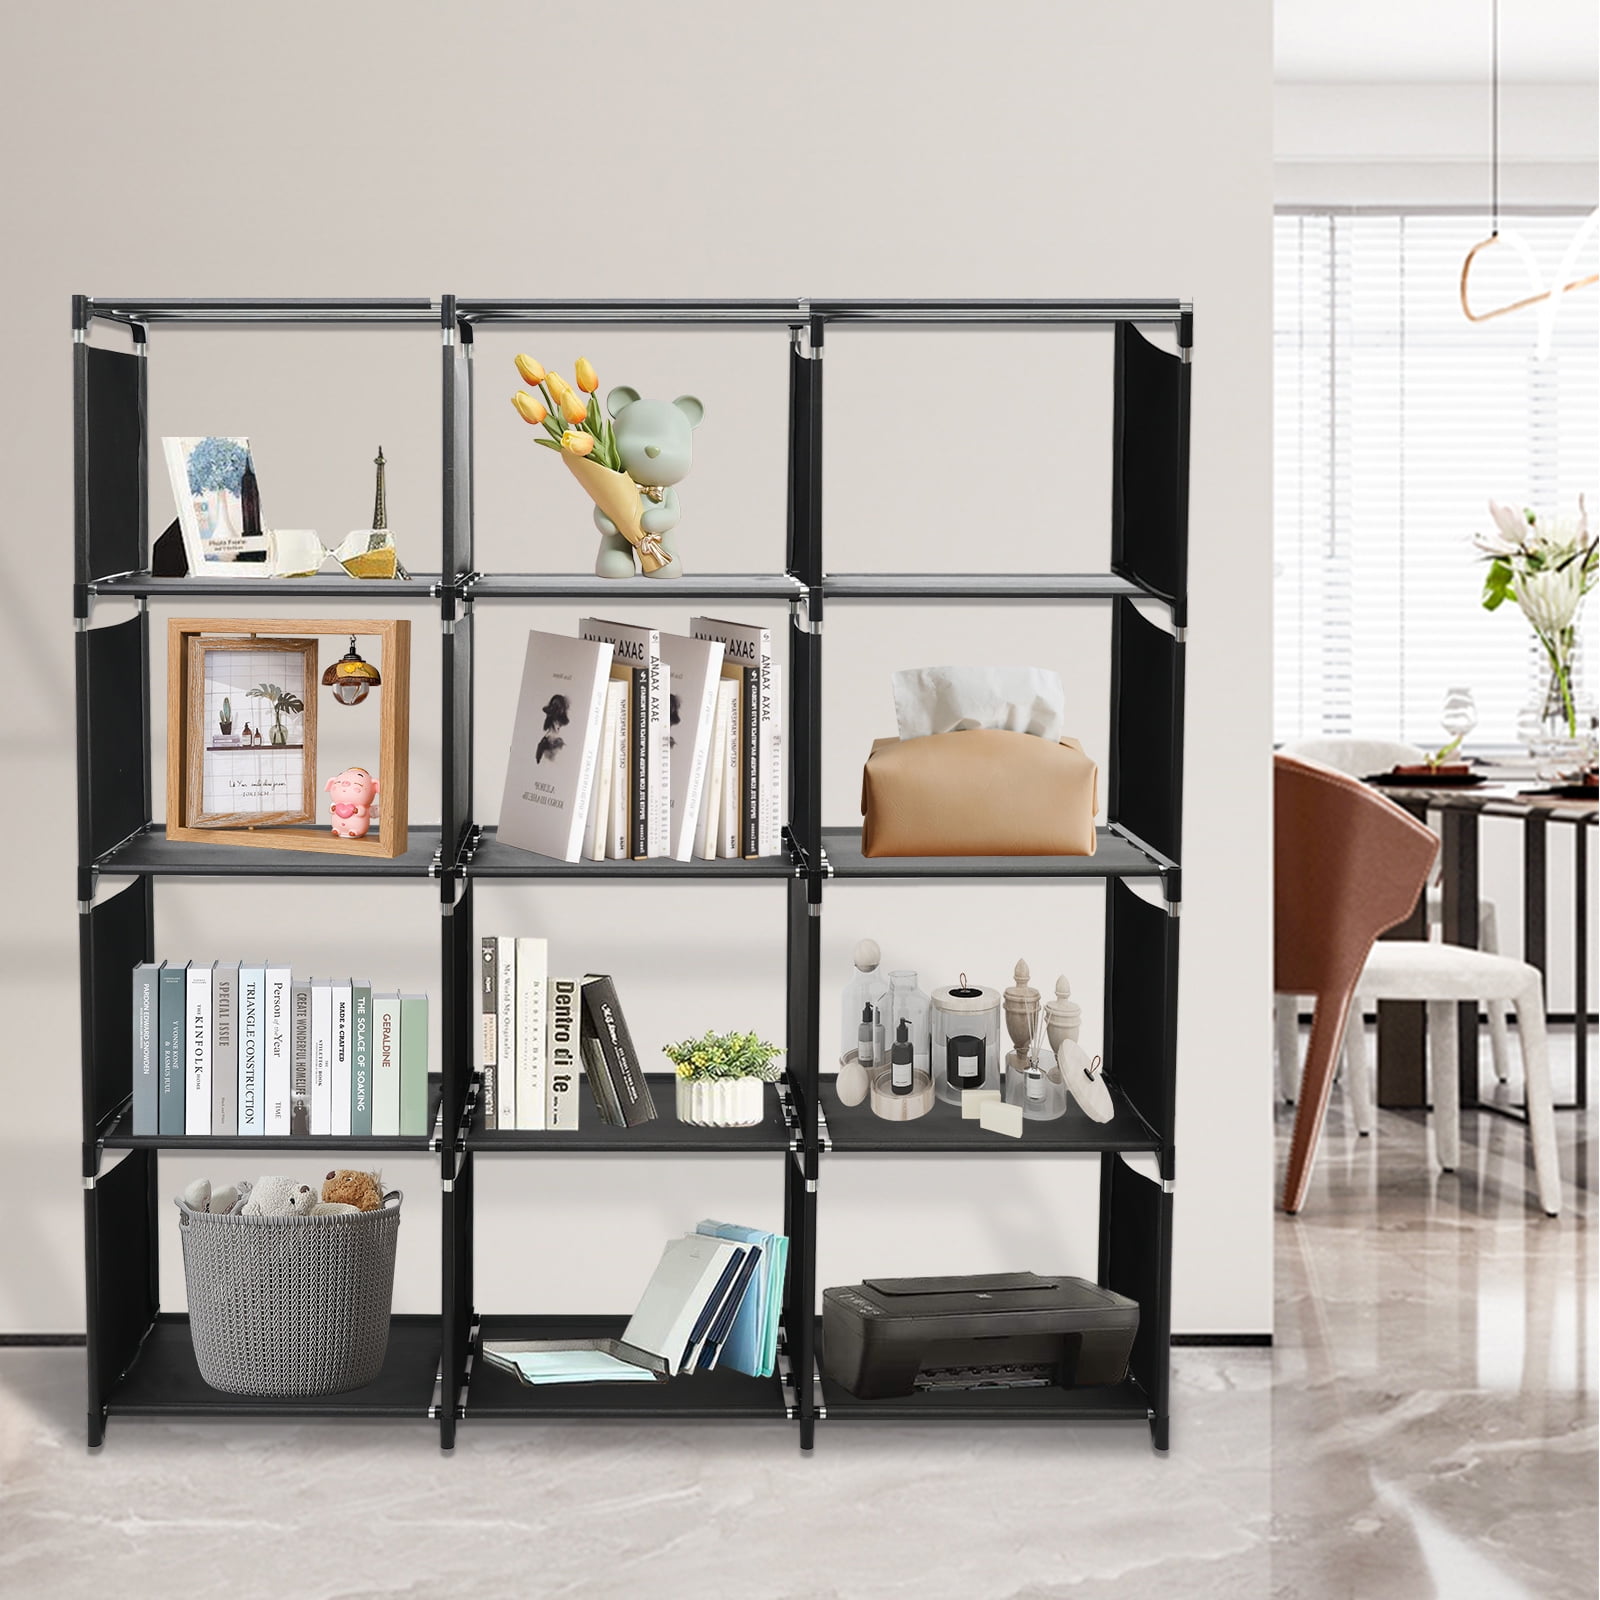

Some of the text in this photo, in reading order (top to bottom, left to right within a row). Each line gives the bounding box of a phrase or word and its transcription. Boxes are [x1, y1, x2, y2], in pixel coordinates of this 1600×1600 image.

[219, 981, 230, 1047] SPECIAL ISSUE
[273, 982, 284, 1018] Person
[195, 1016, 203, 1074] KINFOLK
[245, 981, 256, 1125] TRIANGLE CONSTRUCTION
[274, 1034, 283, 1058] Year
[296, 992, 307, 1096] CREATE WONDERFUL HOMELIFE
[338, 1030, 346, 1063] CRAFTED
[356, 997, 366, 1112] THE SOLACE OF SOAKING
[382, 1013, 392, 1069] GERALDINE
[553, 981, 576, 1093] Dentro di te
